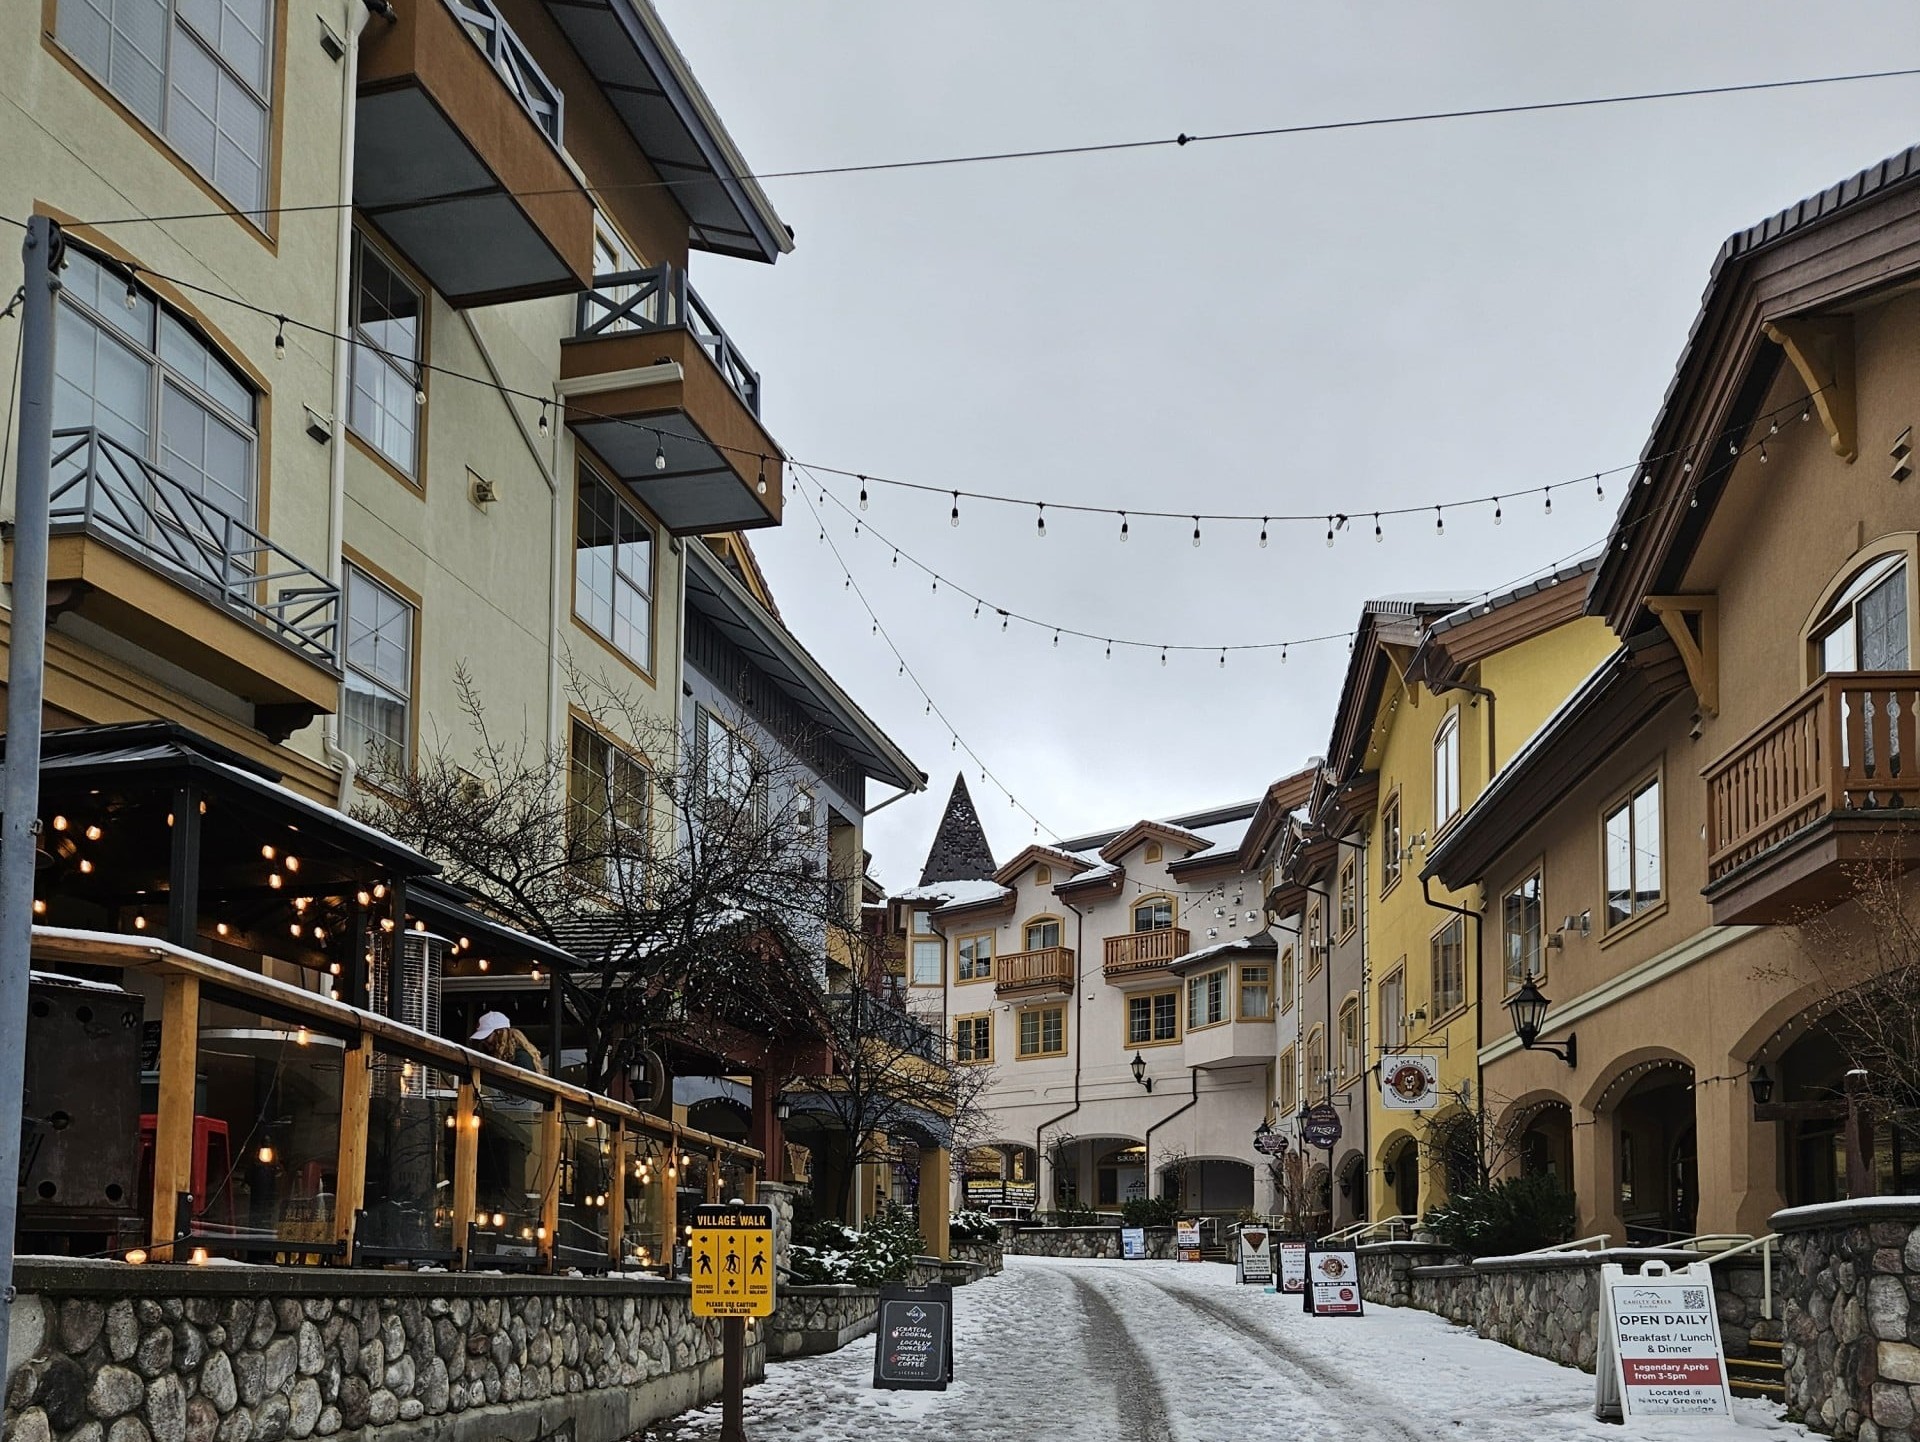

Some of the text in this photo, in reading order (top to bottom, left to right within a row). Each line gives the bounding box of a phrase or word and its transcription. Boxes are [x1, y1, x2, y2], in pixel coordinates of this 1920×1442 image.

[697, 1215, 766, 1226] VILLAGE WALK
[1620, 1315, 1708, 1326] OPEN DAILY
[1620, 1333, 1671, 1342] Breakfast
[1680, 1334, 1713, 1342] Lunch
[1647, 1345, 1692, 1353] & Dinner
[1633, 1363, 1709, 1372] Legendary Après
[1658, 1372, 1687, 1381] 3-5pm
